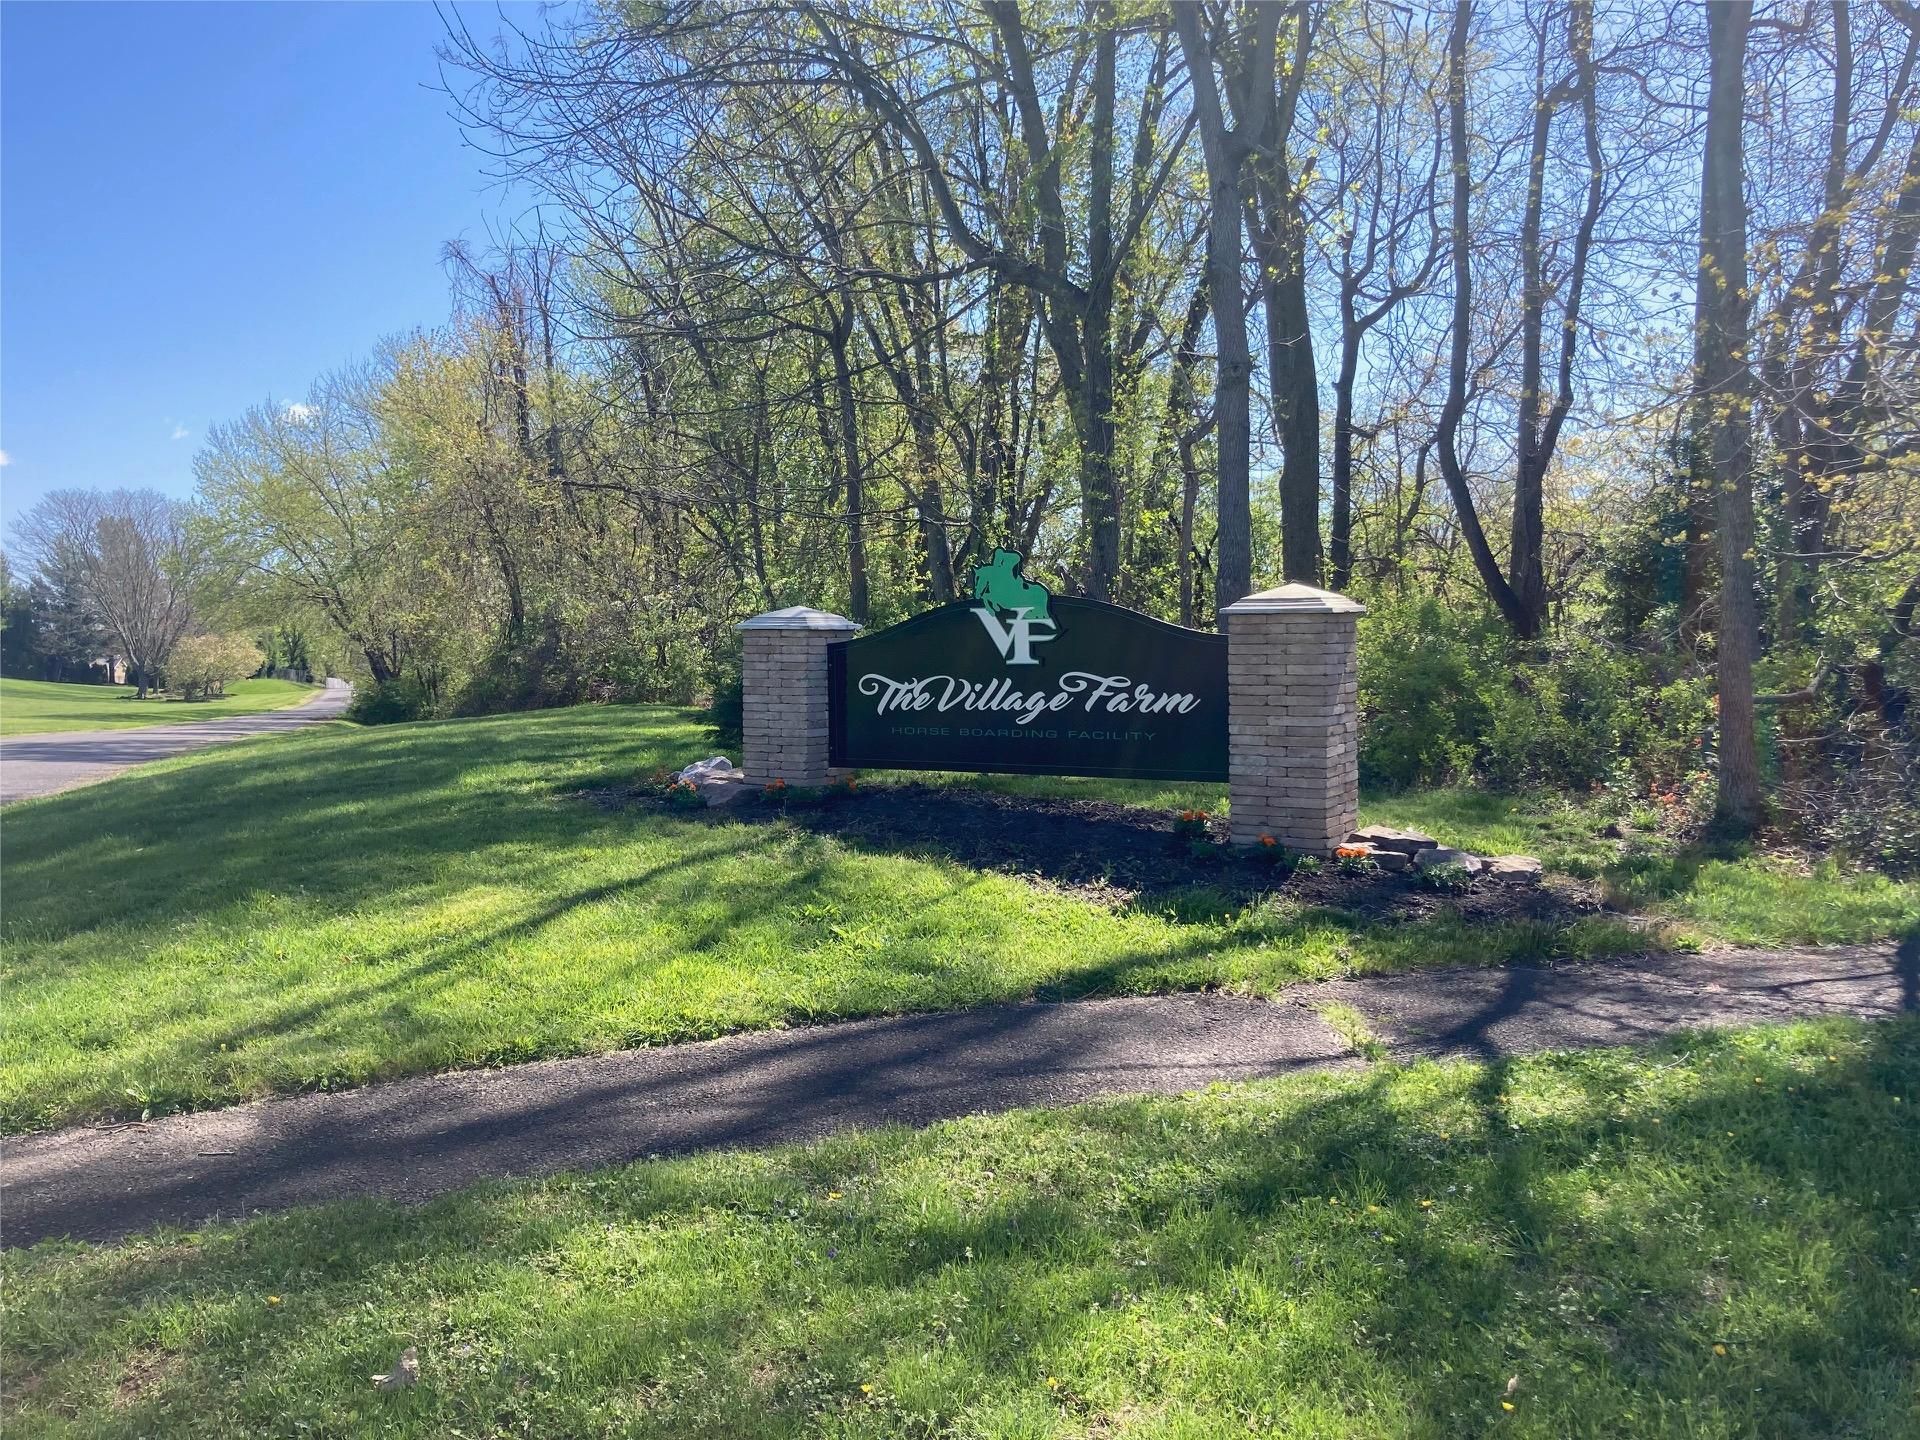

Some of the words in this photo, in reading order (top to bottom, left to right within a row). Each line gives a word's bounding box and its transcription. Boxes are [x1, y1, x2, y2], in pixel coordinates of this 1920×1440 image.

[970, 606, 1058, 665] VF
[858, 673, 936, 716] The
[913, 675, 1075, 725] Village
[1059, 671, 1201, 715] Farm
[891, 726, 951, 737] HORSE
[959, 727, 1058, 739] BOARDING
[1067, 730, 1158, 742] FACILITY
